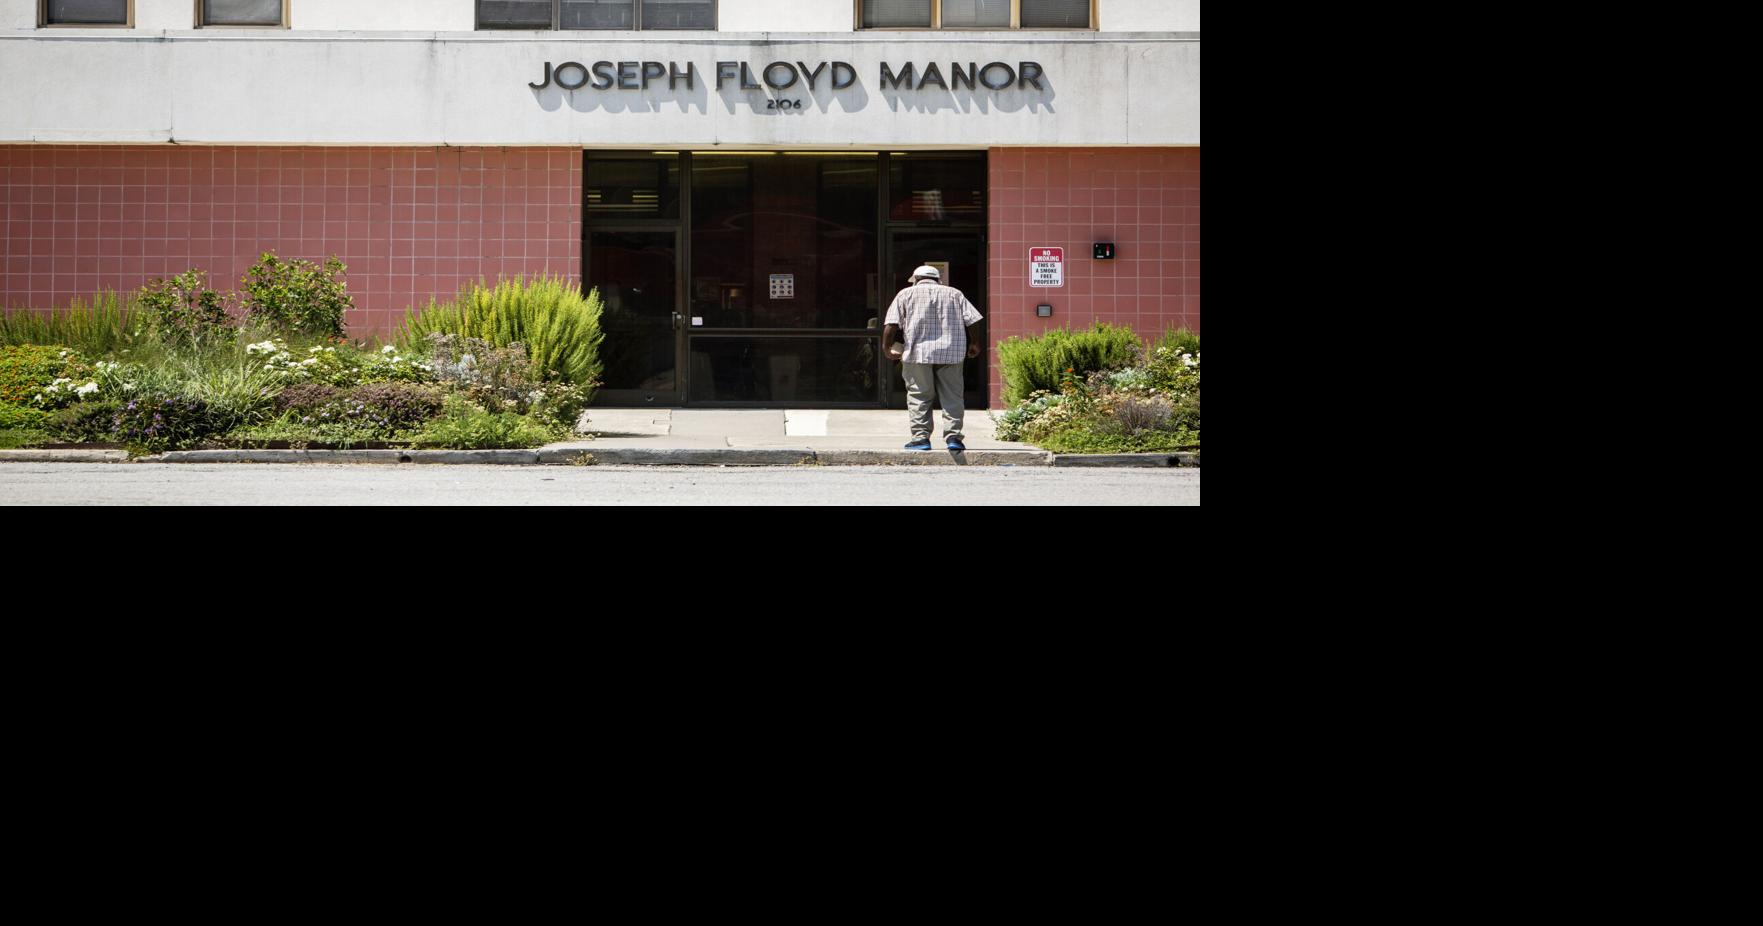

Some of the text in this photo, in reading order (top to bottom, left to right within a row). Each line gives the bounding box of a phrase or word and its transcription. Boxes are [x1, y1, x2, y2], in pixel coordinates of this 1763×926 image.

[528, 60, 1044, 91] JOSEPH FLOYD MANOR
[767, 99, 802, 110] 2106
